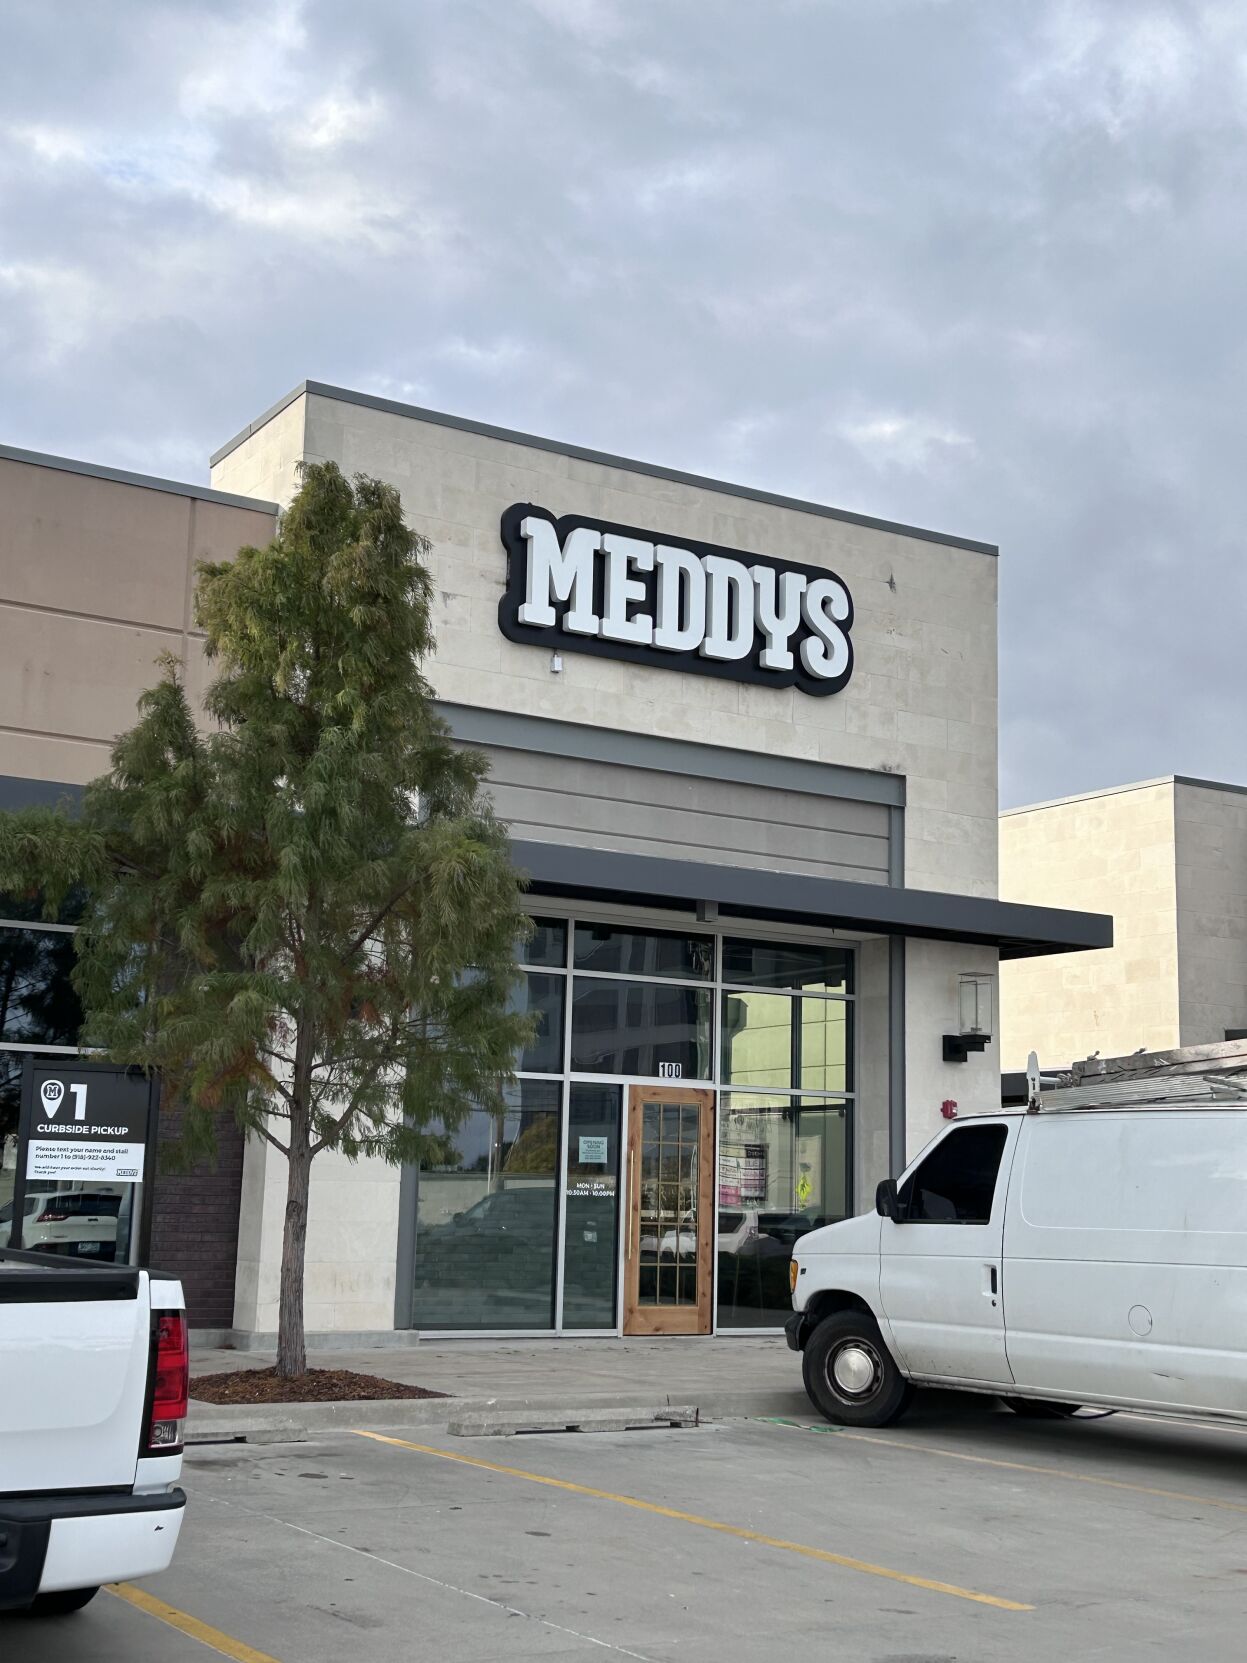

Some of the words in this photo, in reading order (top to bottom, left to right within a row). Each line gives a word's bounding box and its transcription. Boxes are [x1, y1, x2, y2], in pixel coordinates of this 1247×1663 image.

[518, 516, 849, 679] MEDDYS
[660, 1063, 681, 1078] 100
[70, 1083, 87, 1120] 1
[37, 1124, 89, 1134] CURBSIDE
[91, 1126, 128, 1135] PICKUP
